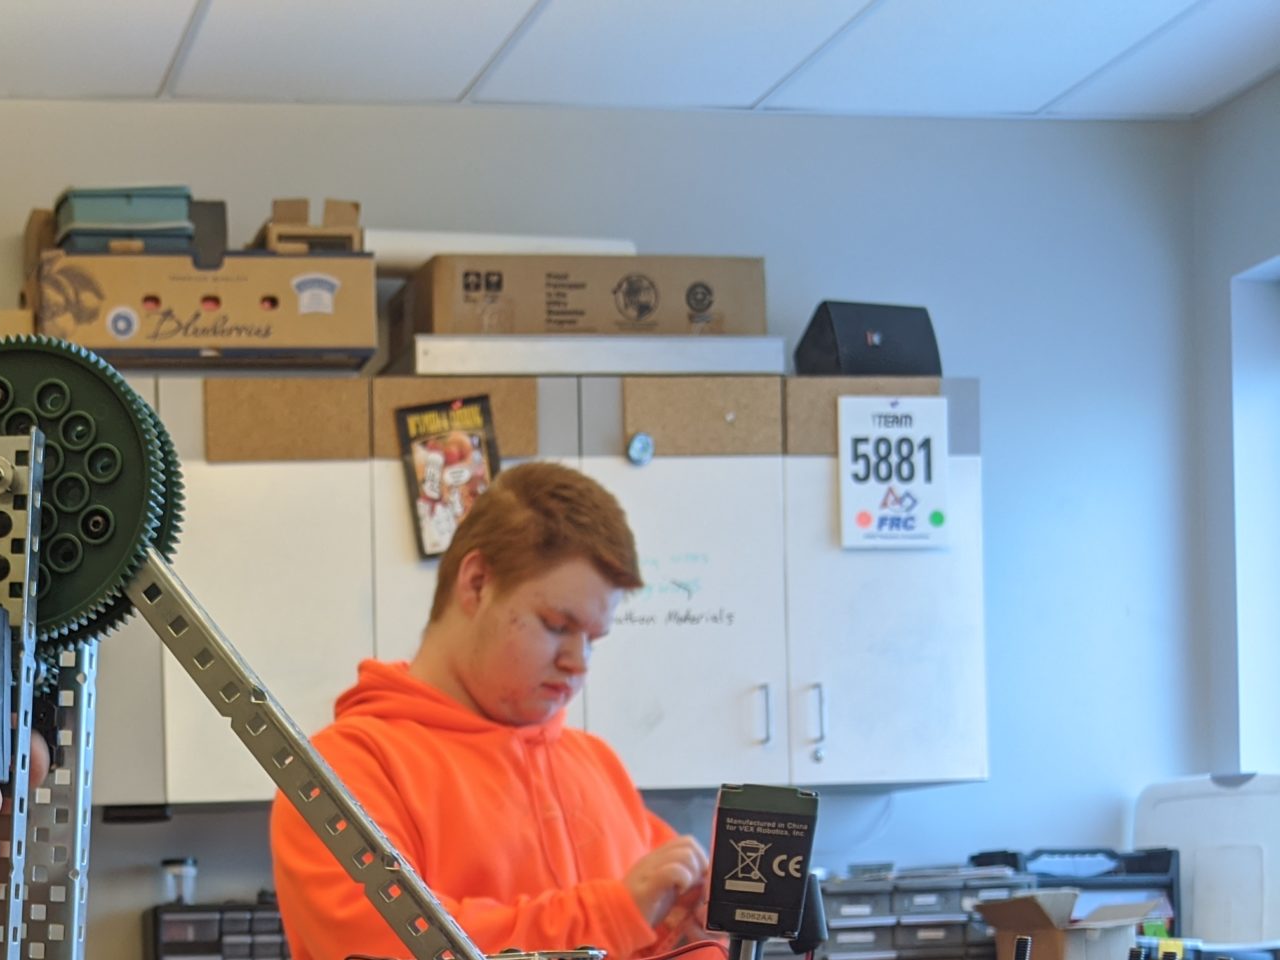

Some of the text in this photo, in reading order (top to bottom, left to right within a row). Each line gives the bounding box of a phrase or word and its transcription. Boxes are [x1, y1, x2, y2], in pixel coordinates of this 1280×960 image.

[144, 308, 273, 341] Blueberries
[851, 436, 933, 485] 5881
[876, 515, 917, 531] FRC
[726, 817, 776, 828] Manufactured
[786, 822, 809, 830] China
[739, 825, 754, 833] VEX
[772, 854, 804, 879] CE
